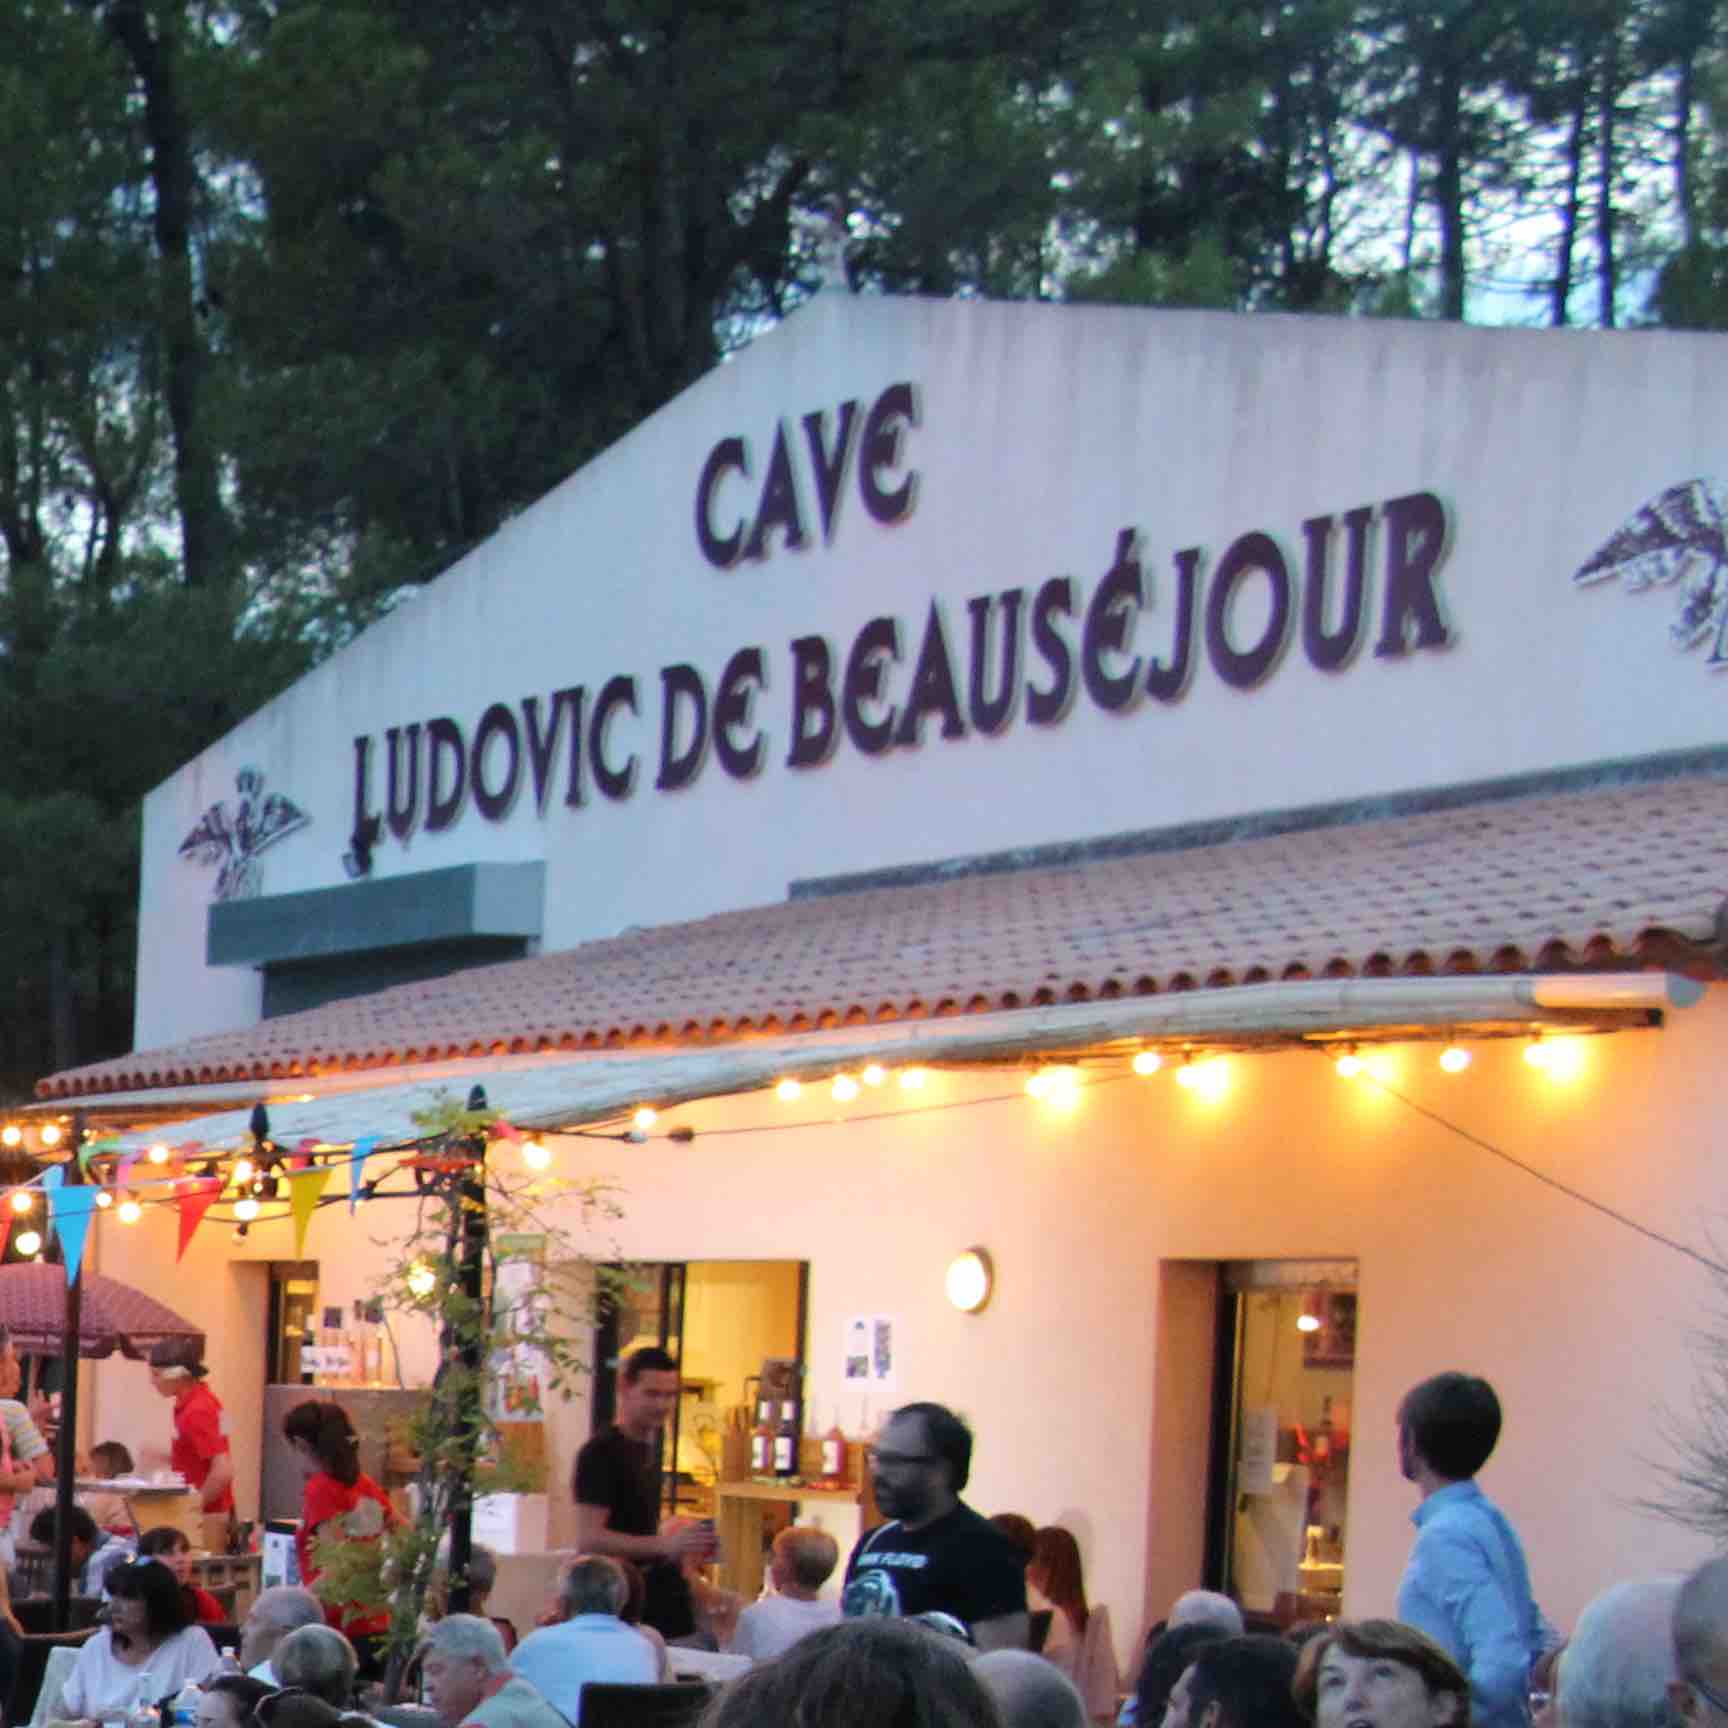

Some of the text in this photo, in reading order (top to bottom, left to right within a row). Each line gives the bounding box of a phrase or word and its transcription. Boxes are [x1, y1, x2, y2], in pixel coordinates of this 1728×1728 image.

[695, 381, 917, 570] CAVE
[350, 490, 1454, 848] LUDOVIC DE BEAUSÉJOUR
